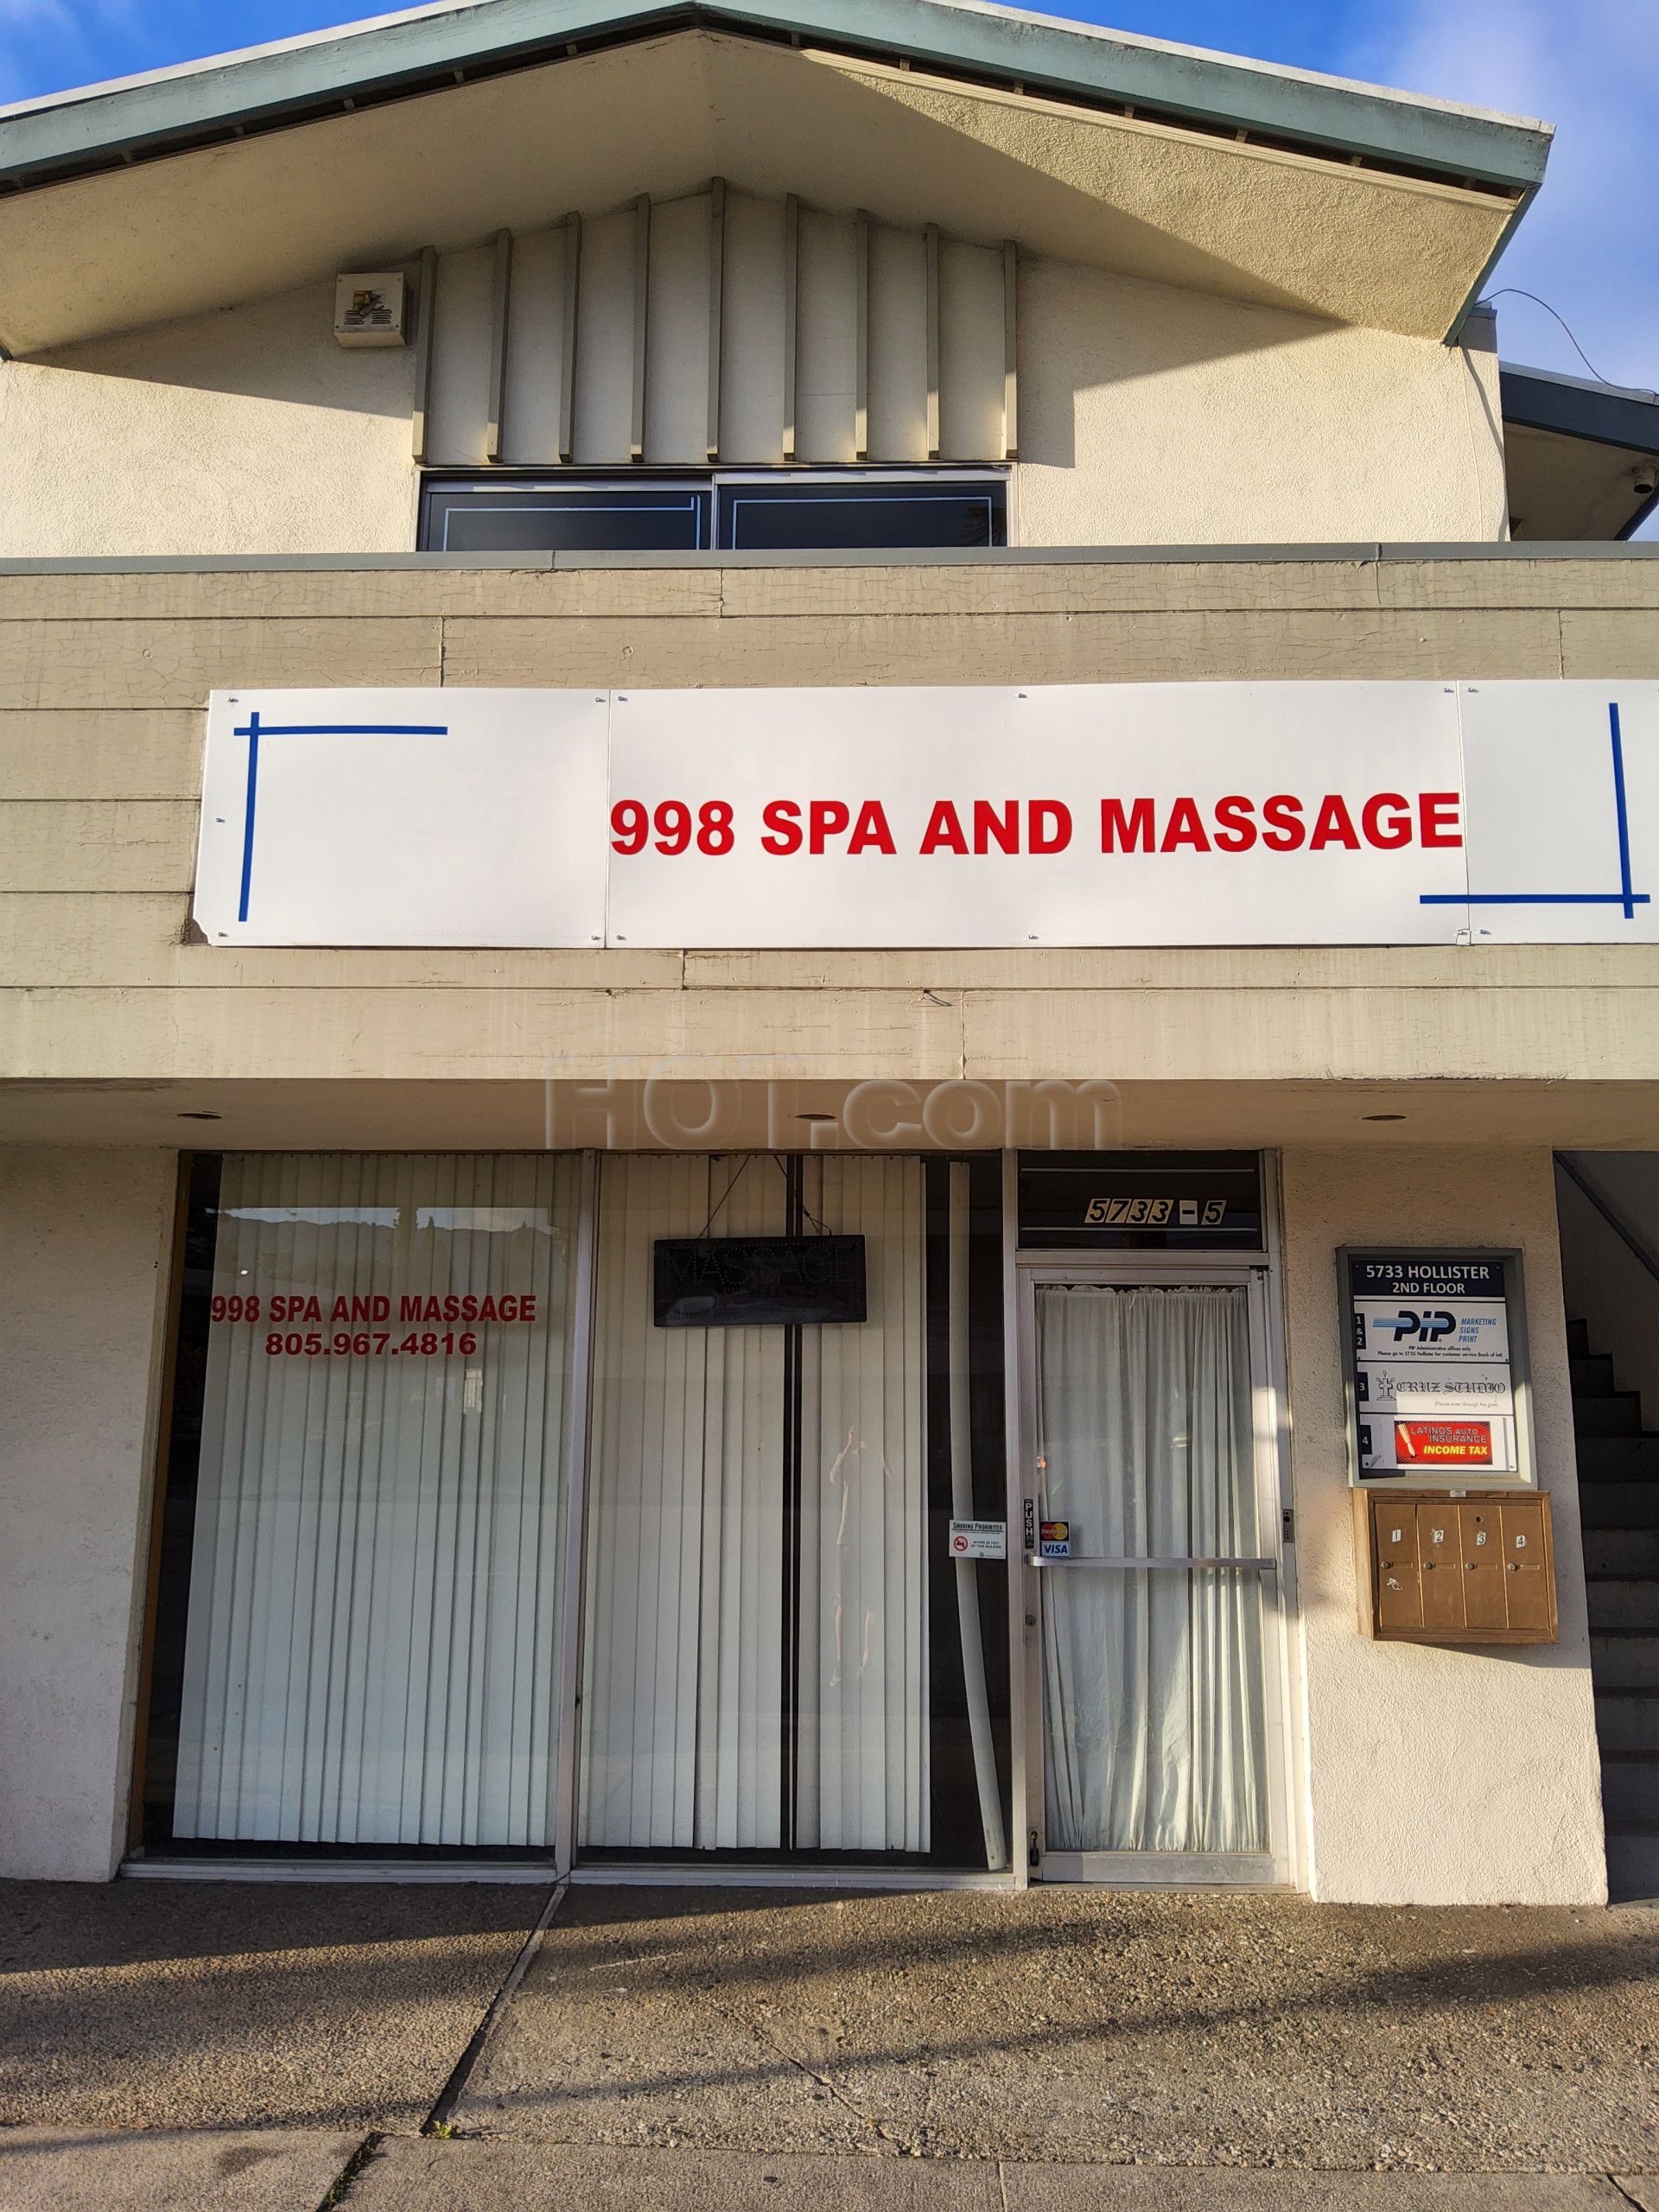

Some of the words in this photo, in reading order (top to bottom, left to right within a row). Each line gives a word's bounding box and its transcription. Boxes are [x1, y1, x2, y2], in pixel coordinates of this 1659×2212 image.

[610, 799, 734, 855] 998
[760, 800, 897, 855] SPA
[919, 800, 1072, 855] AND
[1101, 792, 1464, 854] MASSAGE
[1366, 1265, 1403, 1278] 5733
[1408, 1266, 1490, 1279] HOLLISTER
[1392, 1282, 1420, 1294] 2ND
[1423, 1283, 1465, 1294] FLOOR
[211, 1295, 260, 1323] 998
[269, 1295, 322, 1323] SPA
[330, 1295, 391, 1323] AND
[399, 1295, 537, 1322] MASSAGE
[1460, 1317, 1497, 1325] MARKETING
[265, 1332, 477, 1356] 805.967.4816
[1359, 1382, 1365, 1391] 3
[1396, 1382, 1440, 1393] CRUZ
[1443, 1382, 1506, 1395] STUDIO
[1411, 1427, 1452, 1435] LATINOS
[1362, 1436, 1369, 1446] 4
[1429, 1434, 1487, 1443] INSURANCE
[1423, 1446, 1465, 1455] INCOME
[1468, 1446, 1488, 1455] TAX
[1025, 1503, 1033, 1535] PUSH
[975, 1522, 1003, 1531] PROHIBITED
[1436, 1532, 1442, 1541] 2
[1478, 1534, 1484, 1543] 3
[1517, 1536, 1523, 1545] 4
[1044, 1544, 1068, 1554] VISA
